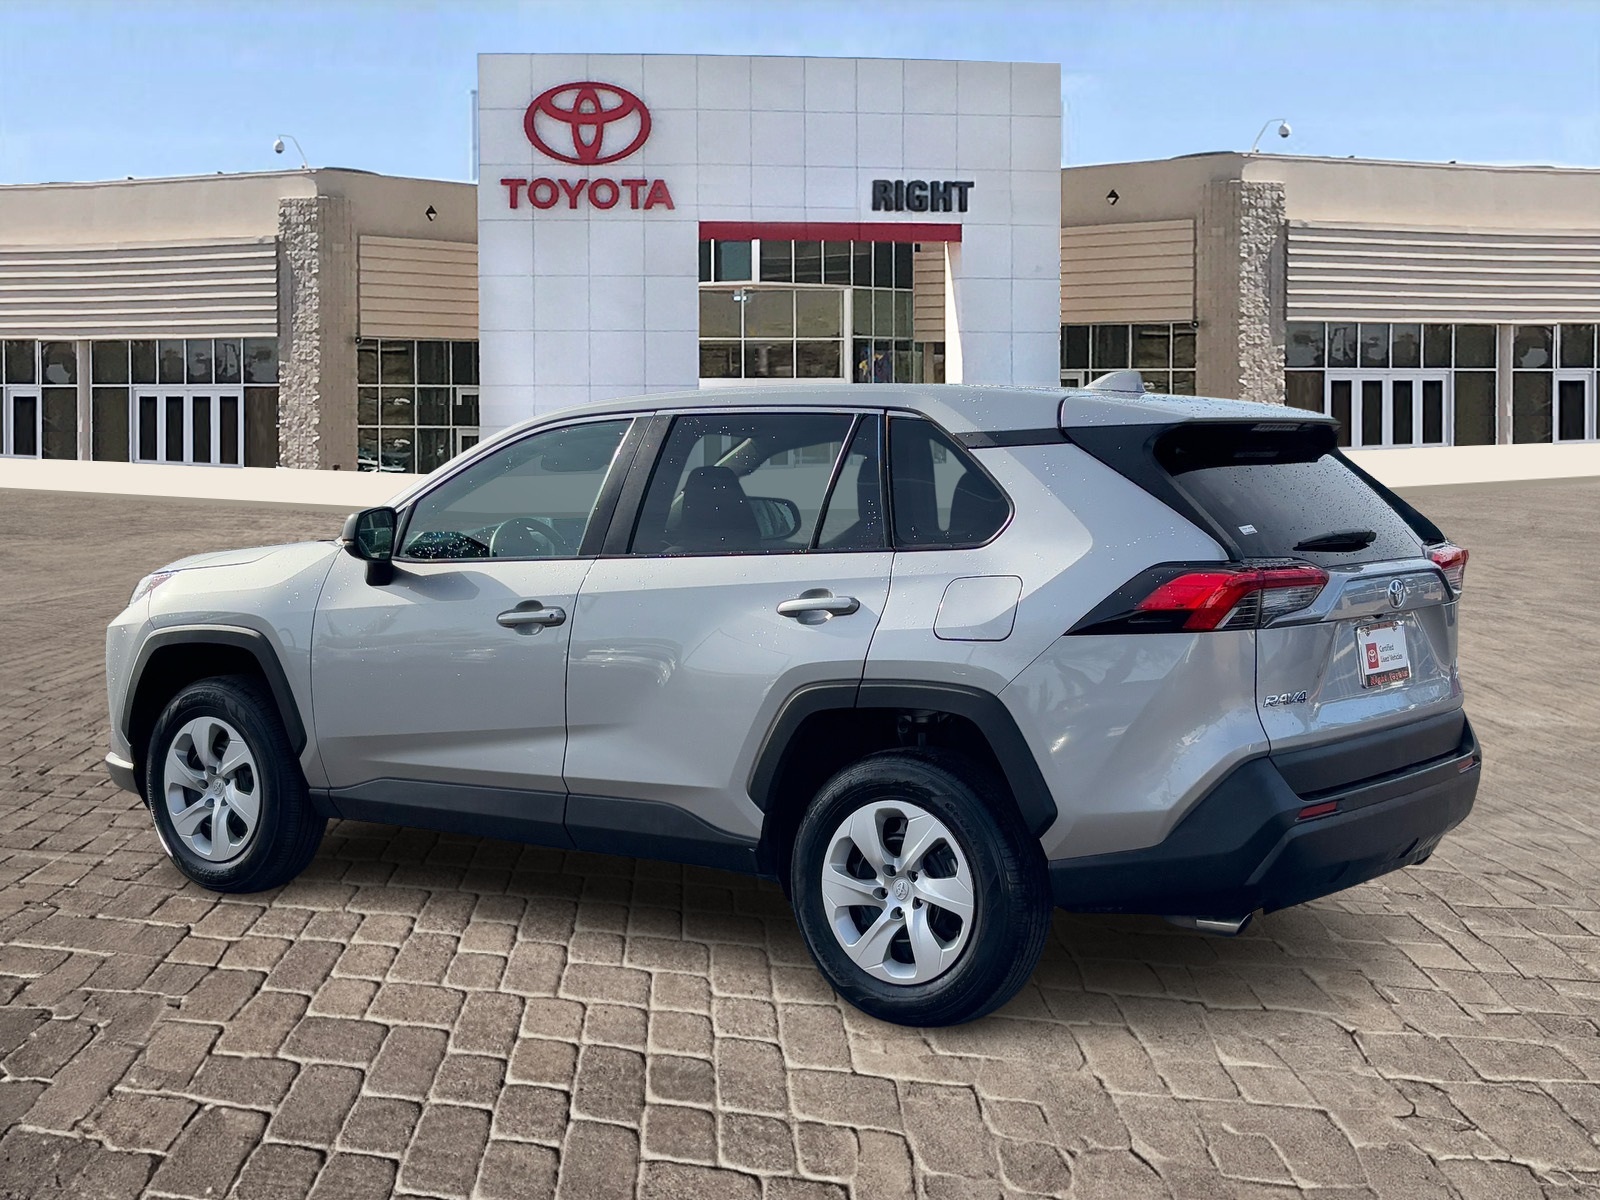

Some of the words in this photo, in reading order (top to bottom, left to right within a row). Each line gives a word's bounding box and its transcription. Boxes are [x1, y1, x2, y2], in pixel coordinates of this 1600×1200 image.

[500, 178, 676, 210] TOYOTA
[872, 180, 975, 212] RIGHT
[1264, 690, 1308, 707] RAV4
